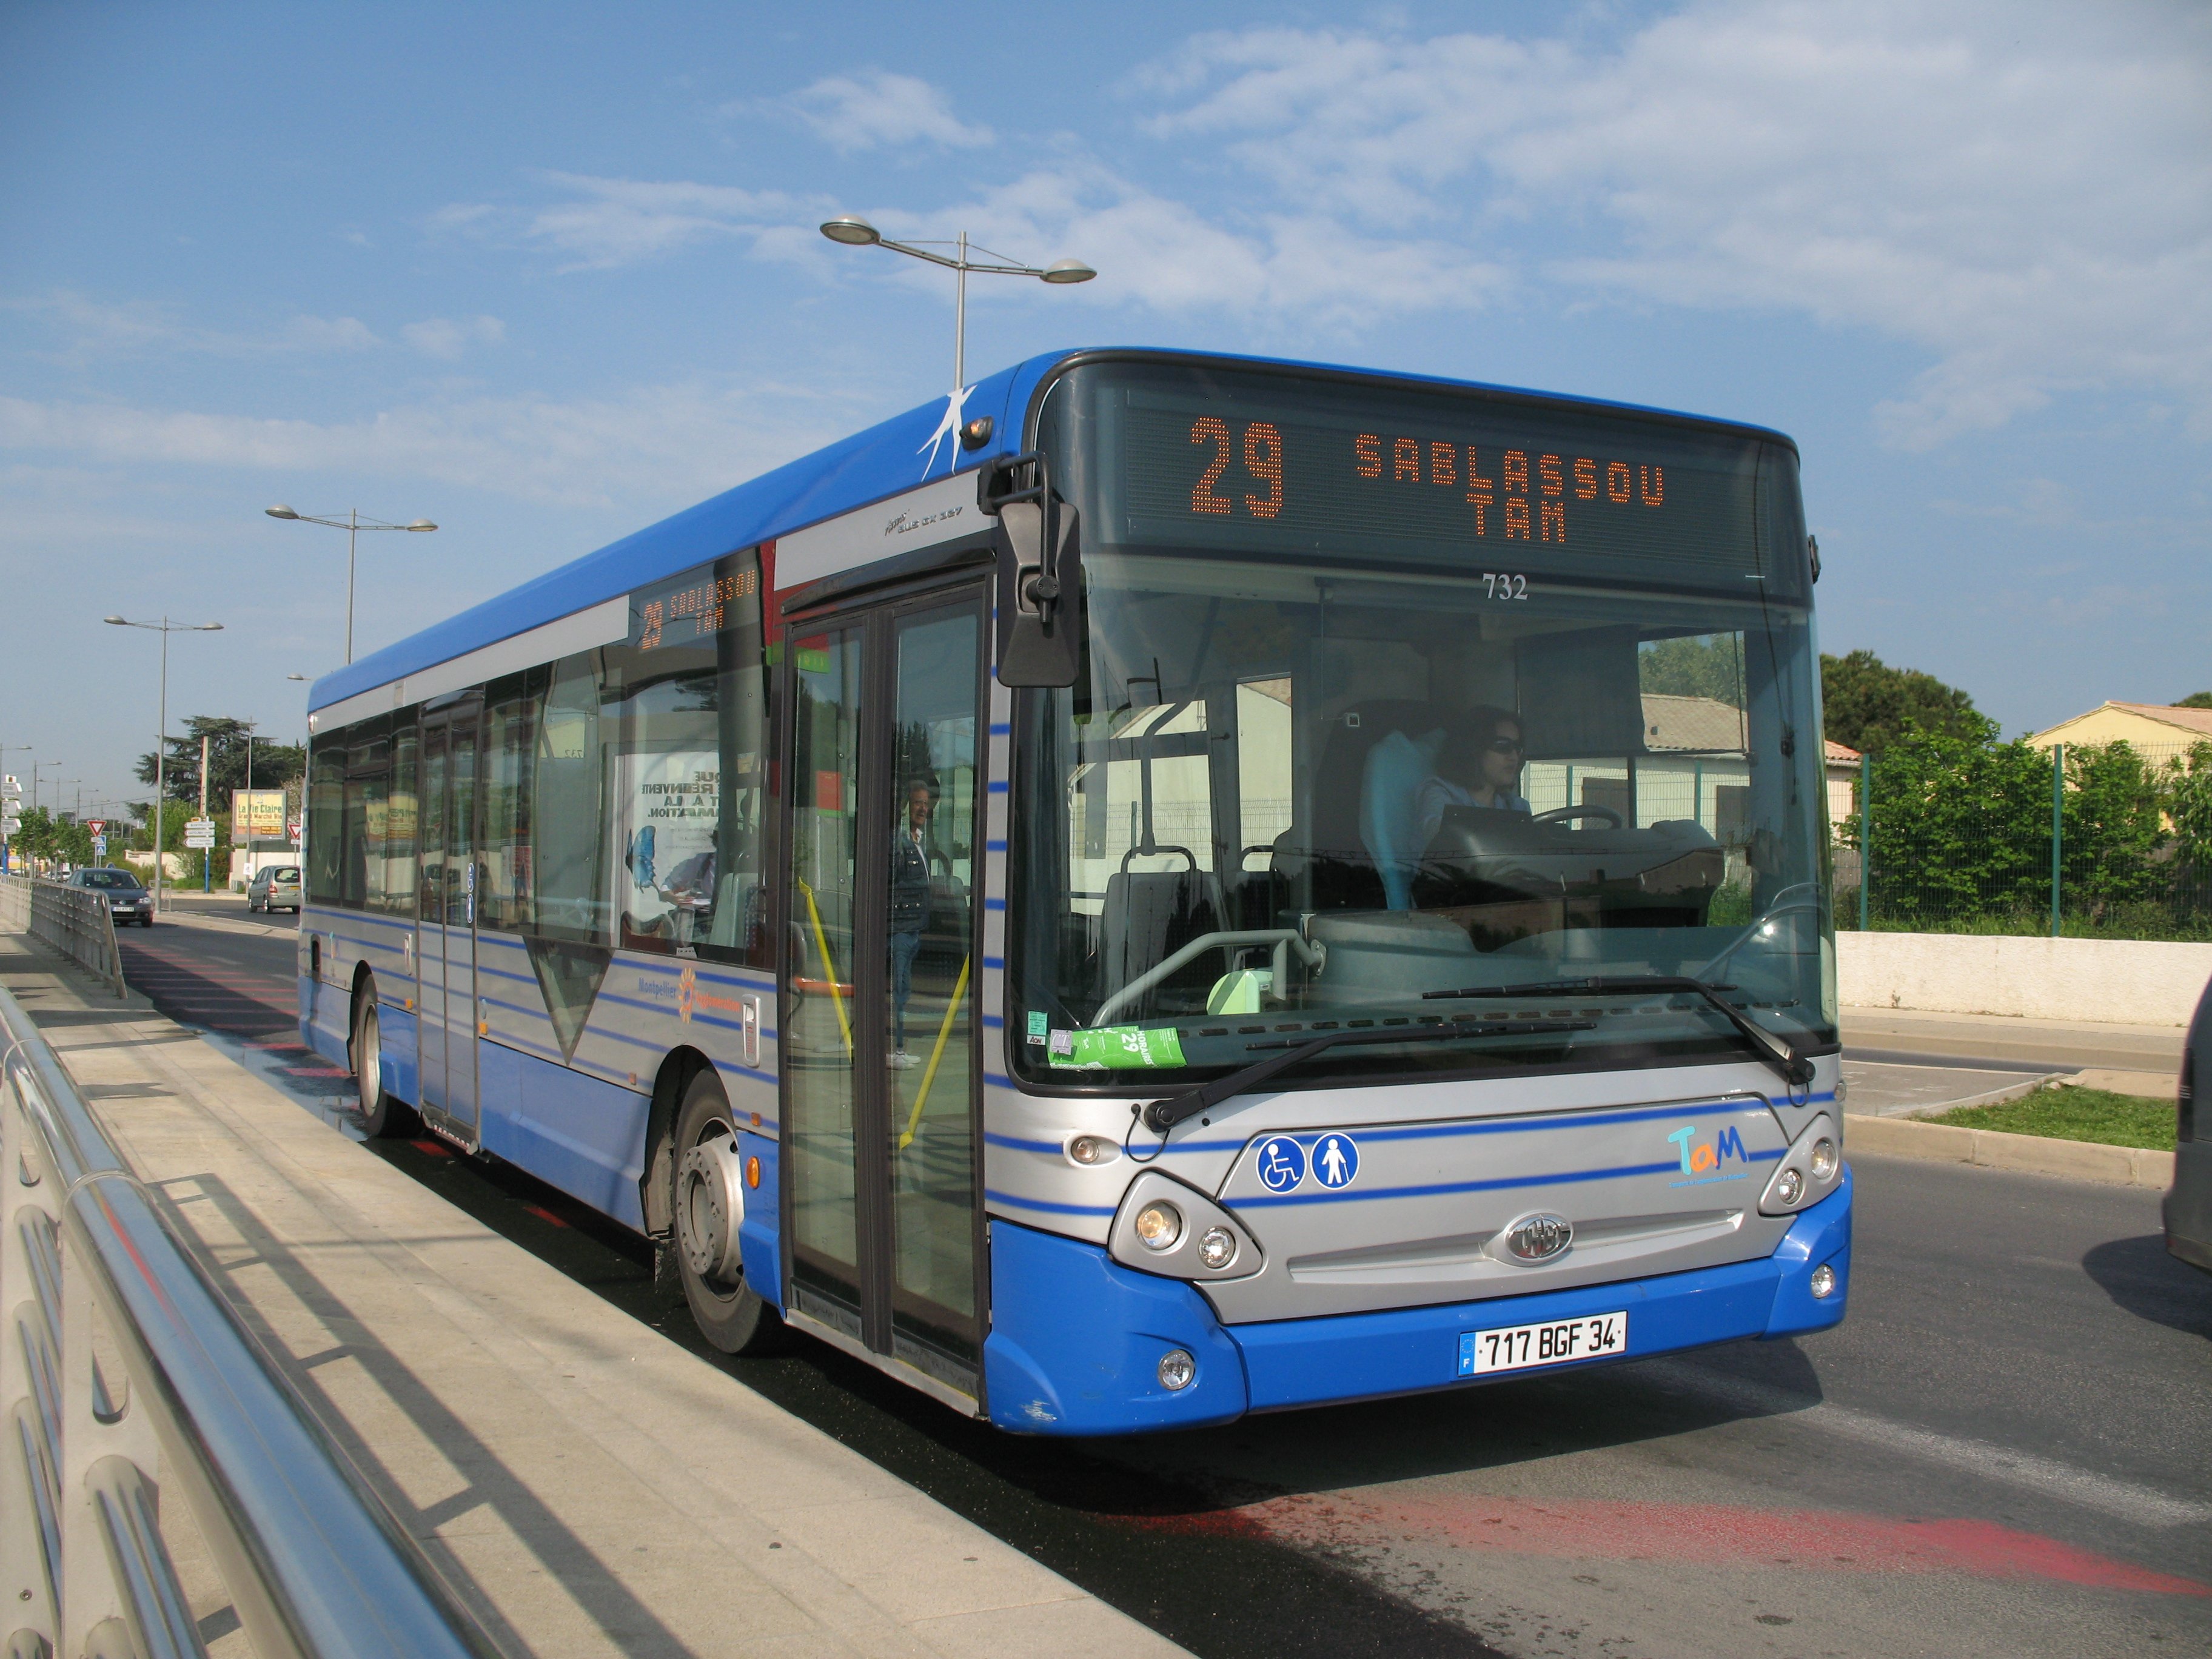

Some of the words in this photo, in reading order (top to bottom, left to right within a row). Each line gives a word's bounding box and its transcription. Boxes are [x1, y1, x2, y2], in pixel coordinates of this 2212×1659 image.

[1190, 416, 1283, 518] 29
[1355, 433, 1664, 506] SABLASSOU
[1467, 492, 1566, 543] TAM
[670, 569, 756, 622] SABLASSOU
[1483, 573, 1528, 600] 732
[260, 804, 282, 813] Claire
[638, 977, 677, 1000] Montpellier
[1122, 1033, 1139, 1053] 29
[1136, 1030, 1155, 1065] HORAIRES
[1486, 1330, 1531, 1366] 717
[1539, 1322, 1583, 1359] BGF
[1589, 1318, 1615, 1352] 34
[1463, 1358, 1470, 1368] F
